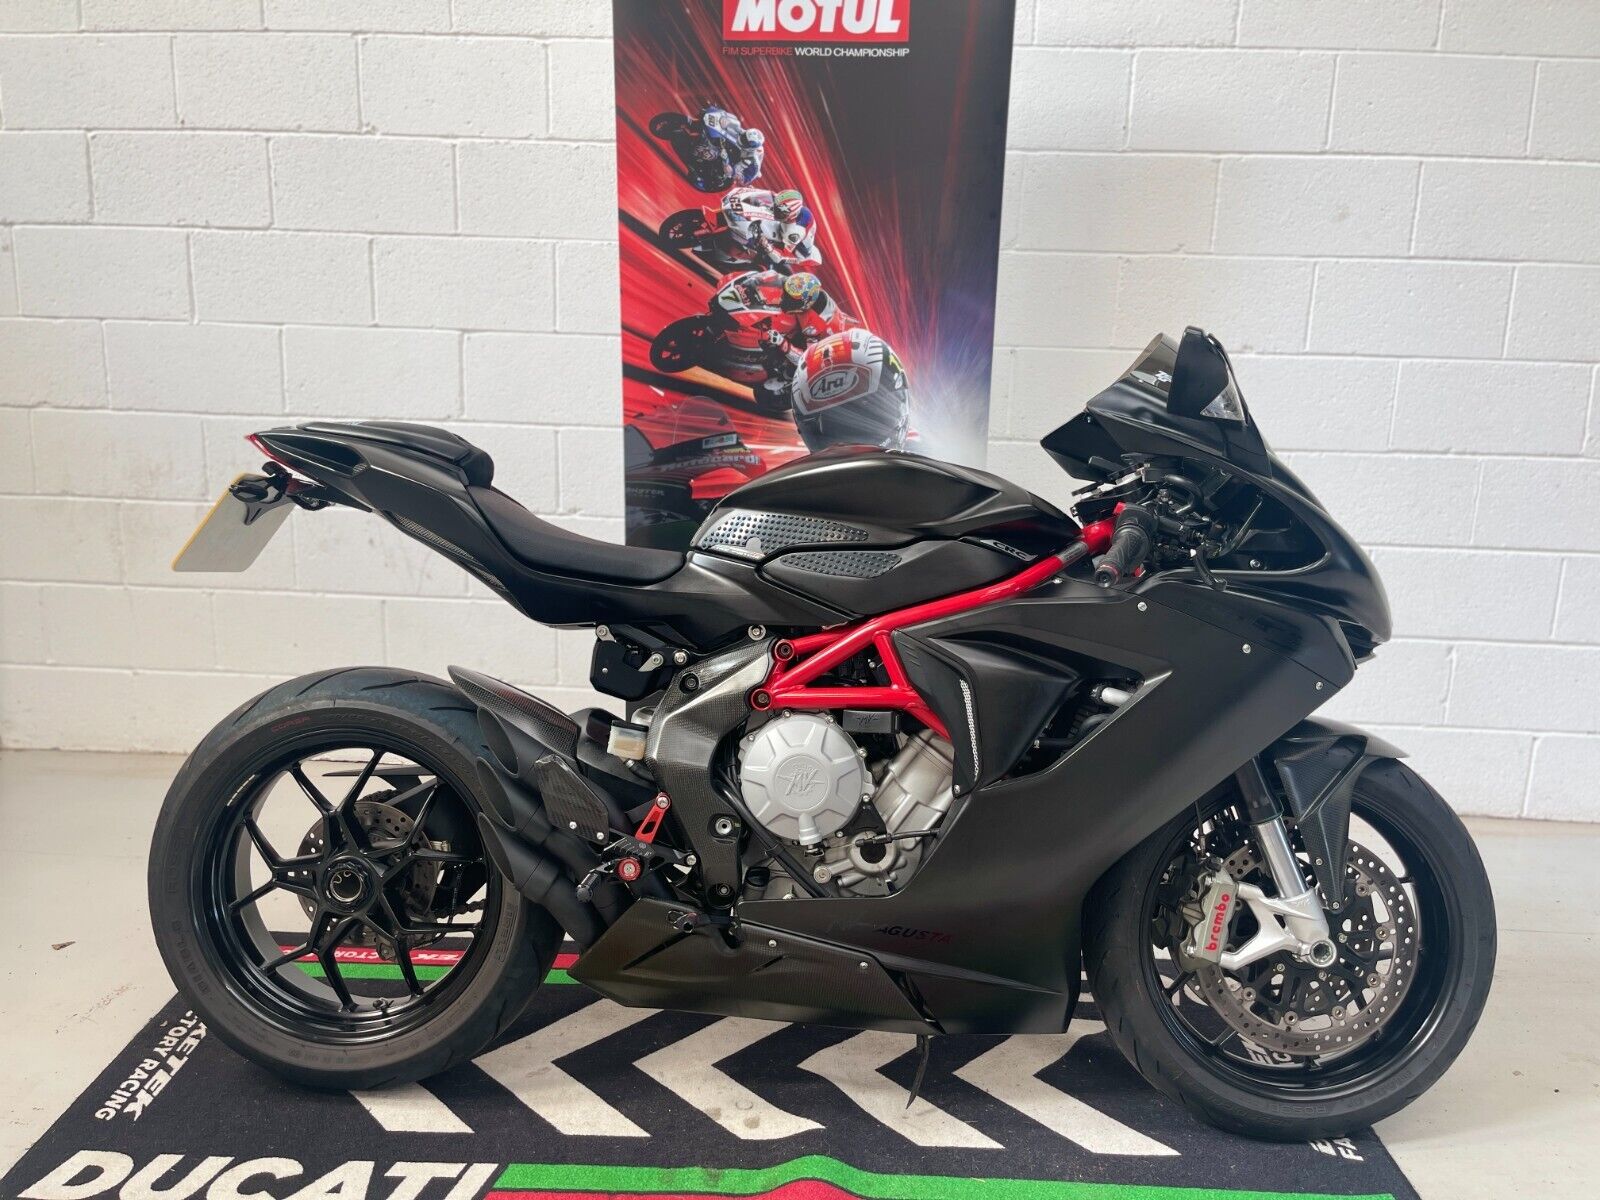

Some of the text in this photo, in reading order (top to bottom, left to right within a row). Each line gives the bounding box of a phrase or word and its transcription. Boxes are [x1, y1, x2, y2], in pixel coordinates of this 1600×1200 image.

[731, 0, 901, 34] MOTUL
[722, 47, 910, 58] FIM SUPERBIKE WORLD CHAMPIONSHIP
[1205, 893, 1231, 951] brembo
[94, 1058, 161, 1121] RACING
[15, 1149, 500, 1200] DUCATI
